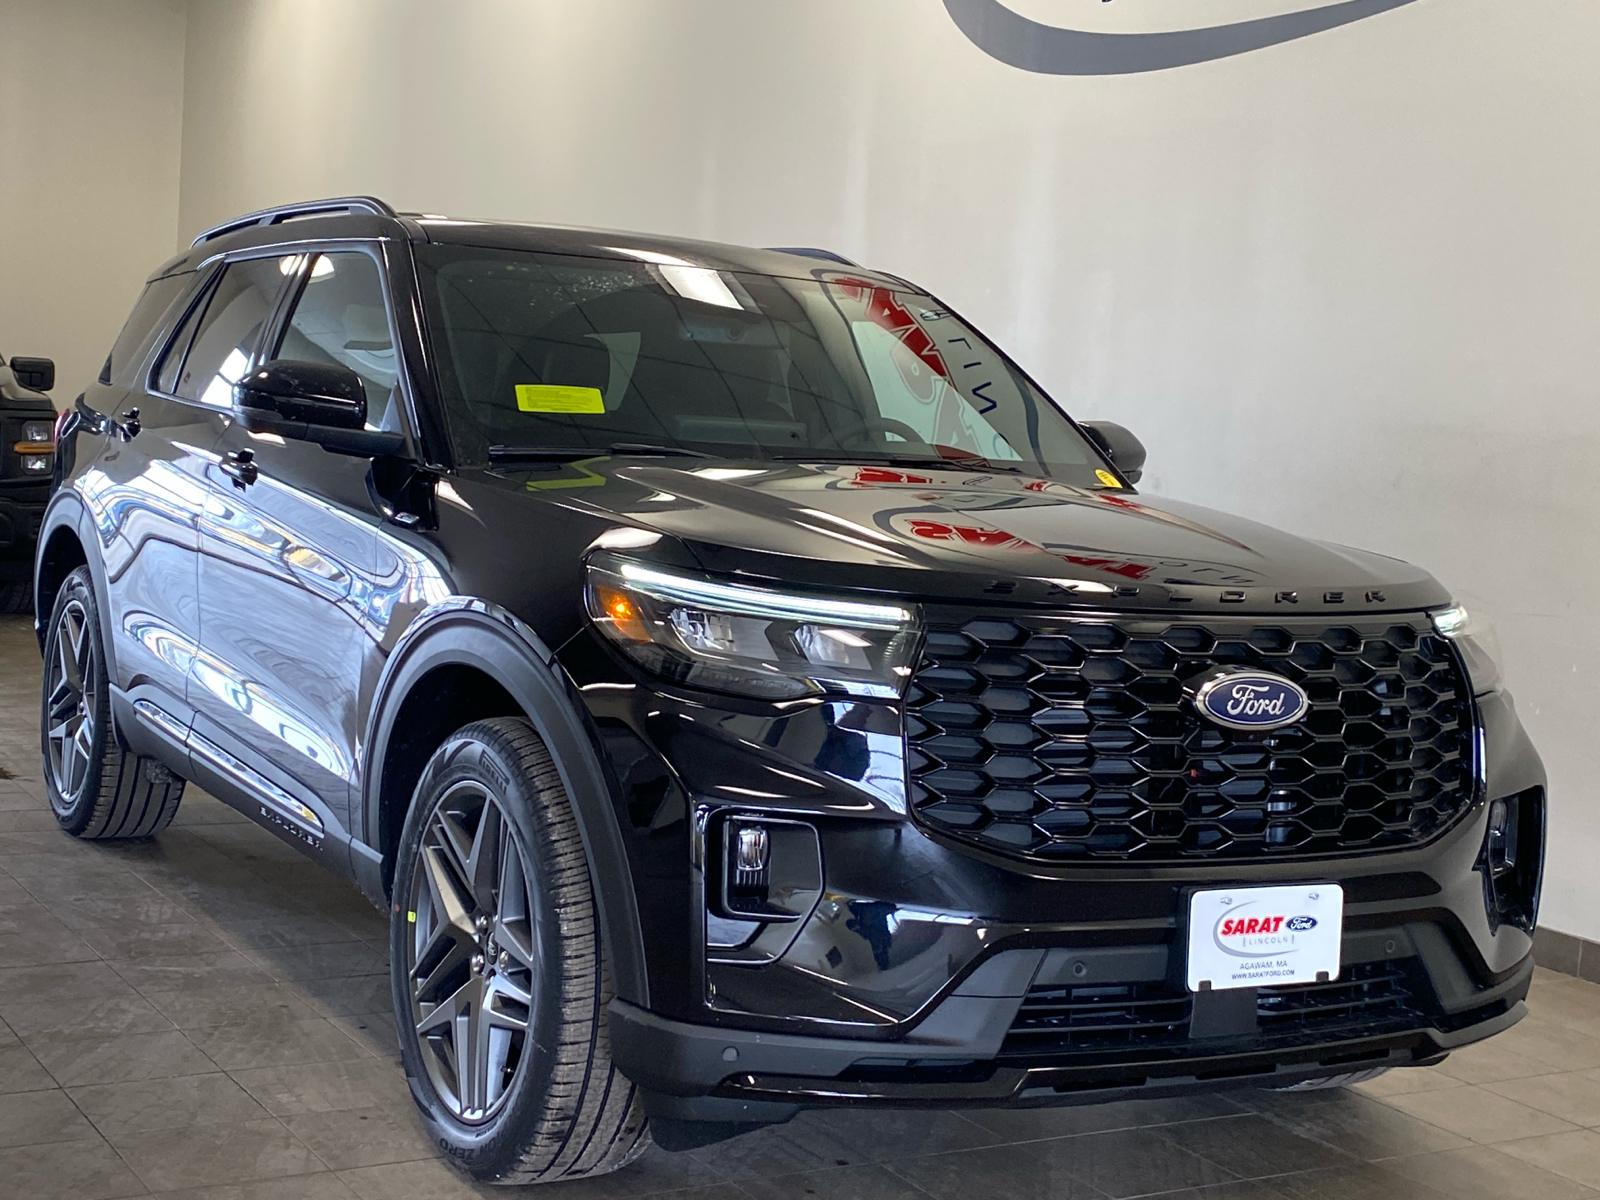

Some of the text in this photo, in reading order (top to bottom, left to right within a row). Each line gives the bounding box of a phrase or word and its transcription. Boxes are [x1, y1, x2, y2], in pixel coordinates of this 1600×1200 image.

[983, 579, 1389, 605] EXPLORER
[1226, 684, 1286, 716] Ford
[479, 749, 511, 796] PIRELLI
[1221, 915, 1313, 936] SARAT Ford
[1248, 937, 1288, 946] LINCOLN
[1231, 970, 1295, 979] WWW.SARATFORD.COM
[1239, 960, 1288, 971] AGAWAM, MA
[440, 1138, 475, 1160] ZERO
